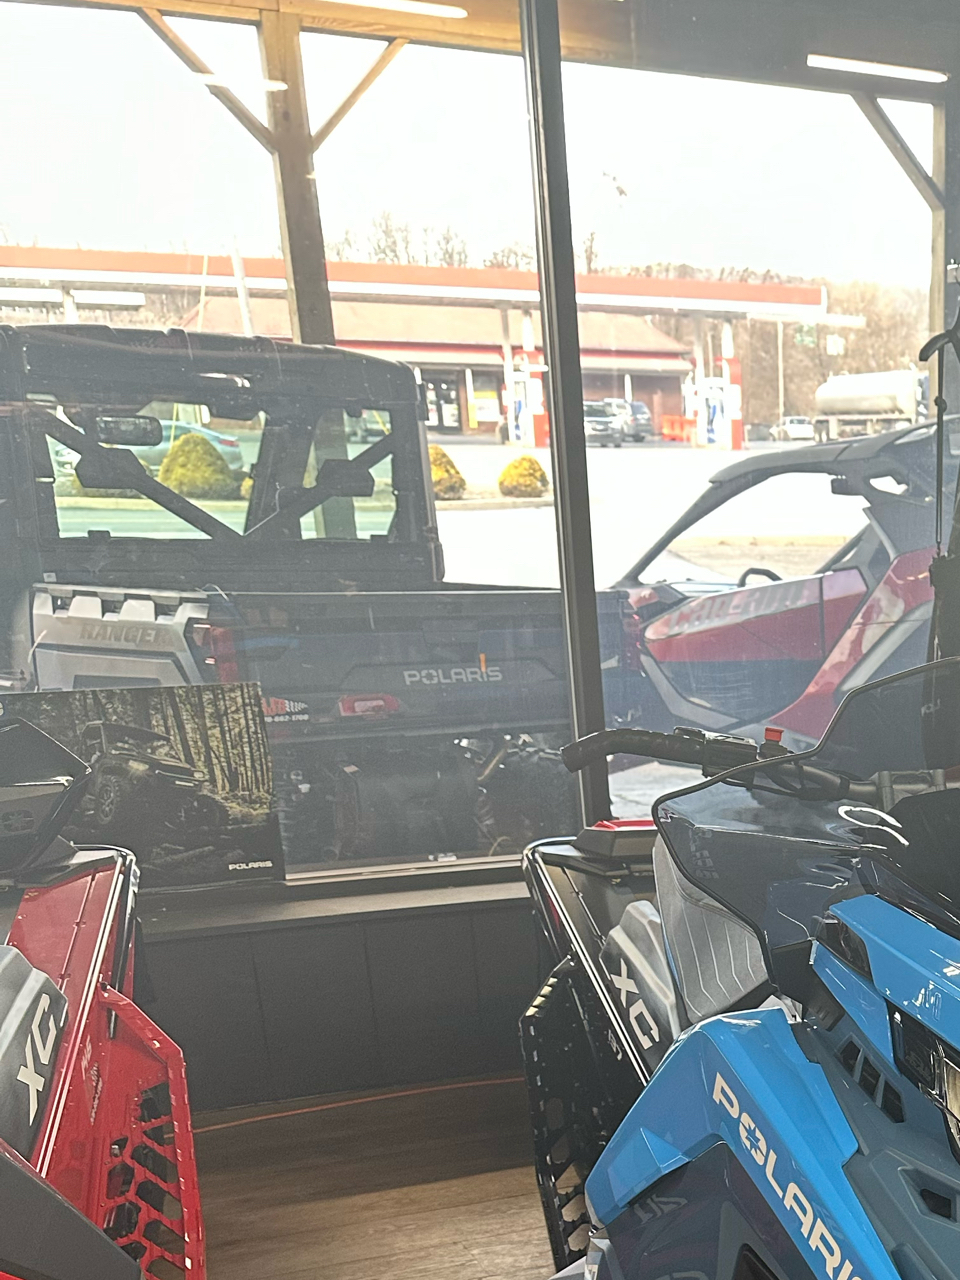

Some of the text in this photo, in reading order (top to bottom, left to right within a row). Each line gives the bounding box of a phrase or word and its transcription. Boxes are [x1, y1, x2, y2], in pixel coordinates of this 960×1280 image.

[403, 667, 503, 685] POLARIS
[228, 860, 273, 870] POLARIS
[610, 958, 660, 1050] XC
[17, 994, 57, 1126] XC
